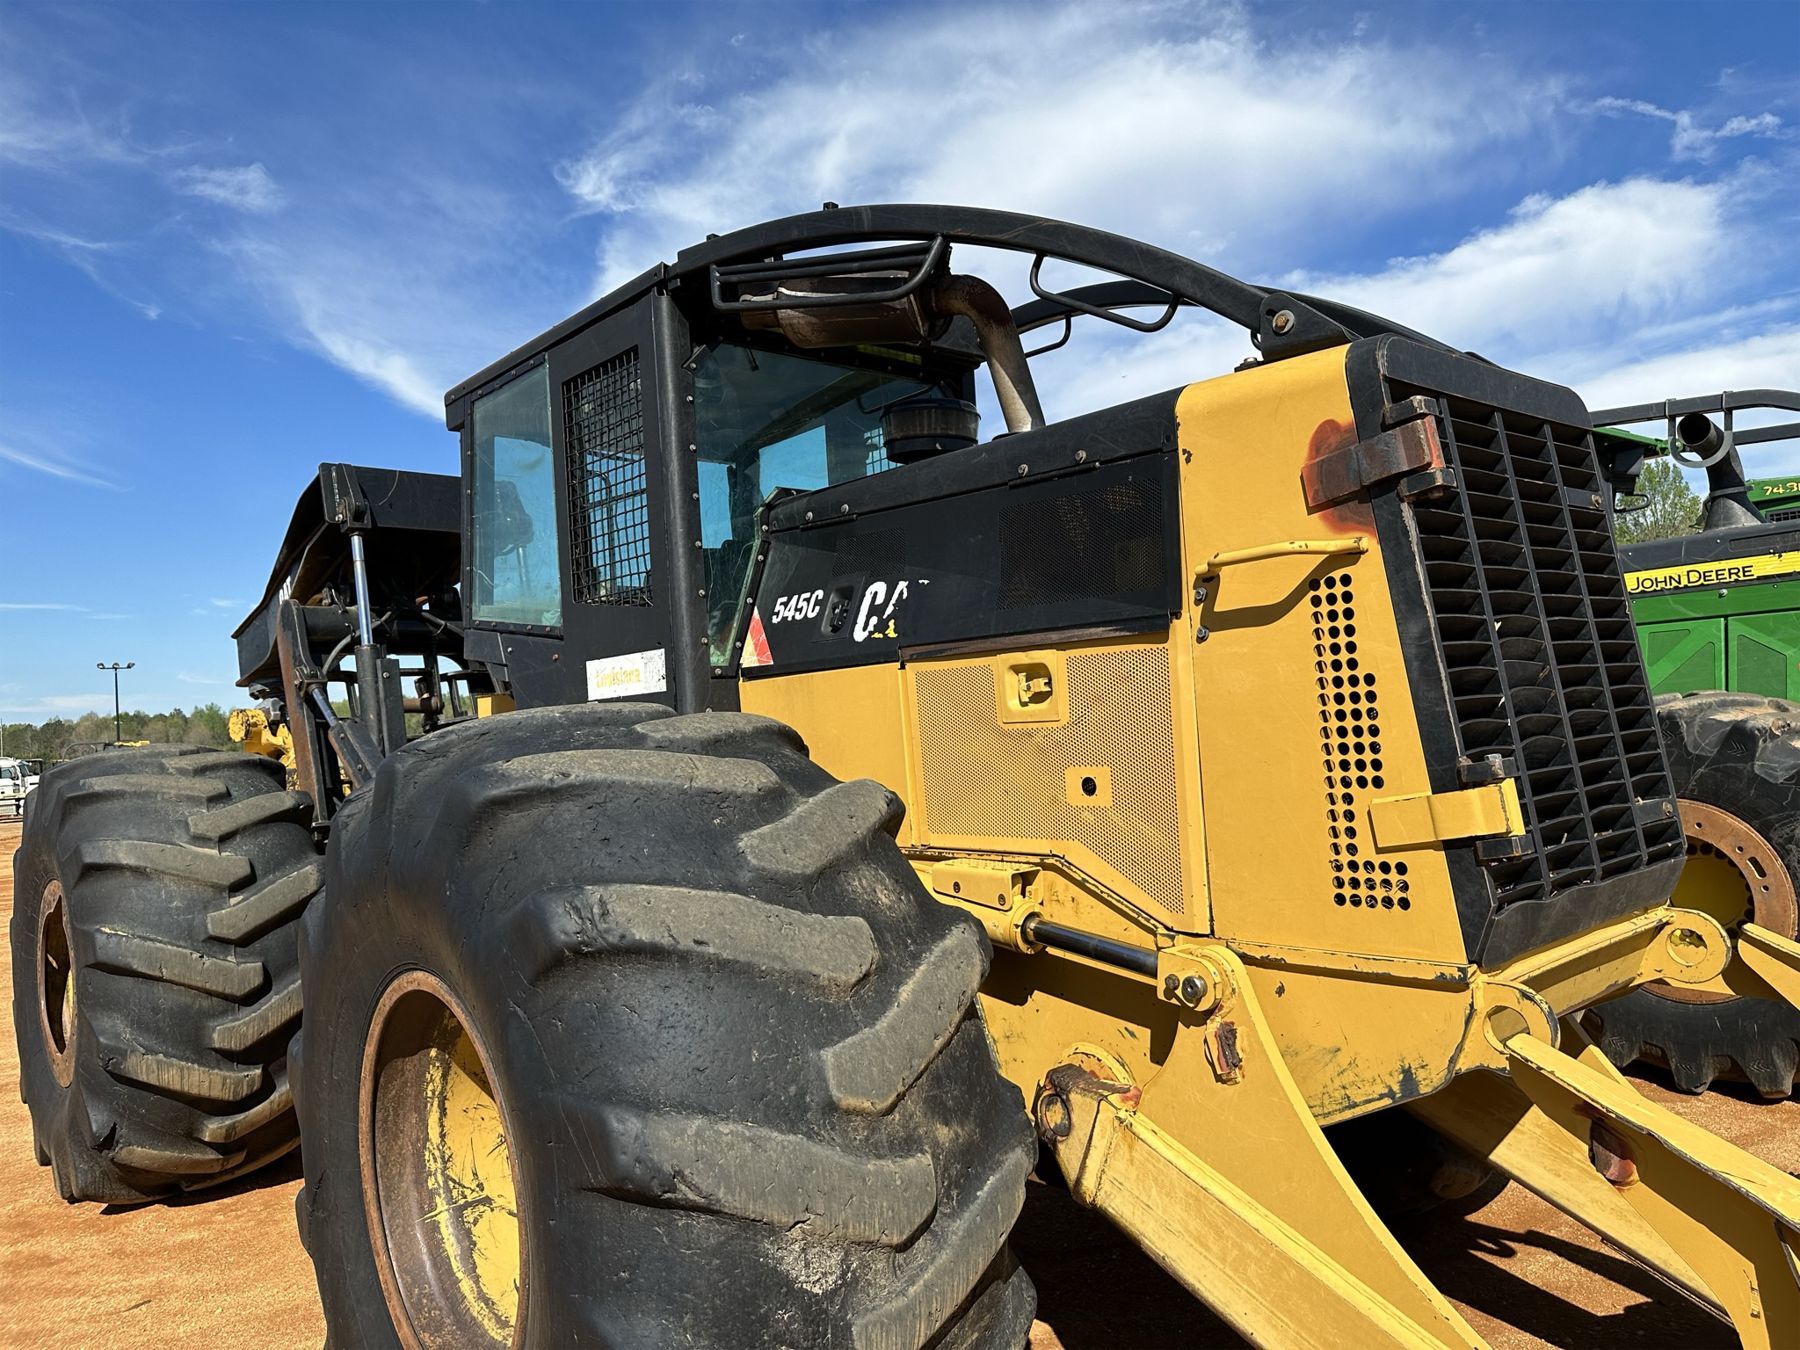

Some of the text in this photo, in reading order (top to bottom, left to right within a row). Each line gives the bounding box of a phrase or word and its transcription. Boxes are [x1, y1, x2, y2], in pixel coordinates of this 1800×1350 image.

[1630, 565, 1754, 591] JOHN DEERE
[771, 589, 824, 623] 545C
